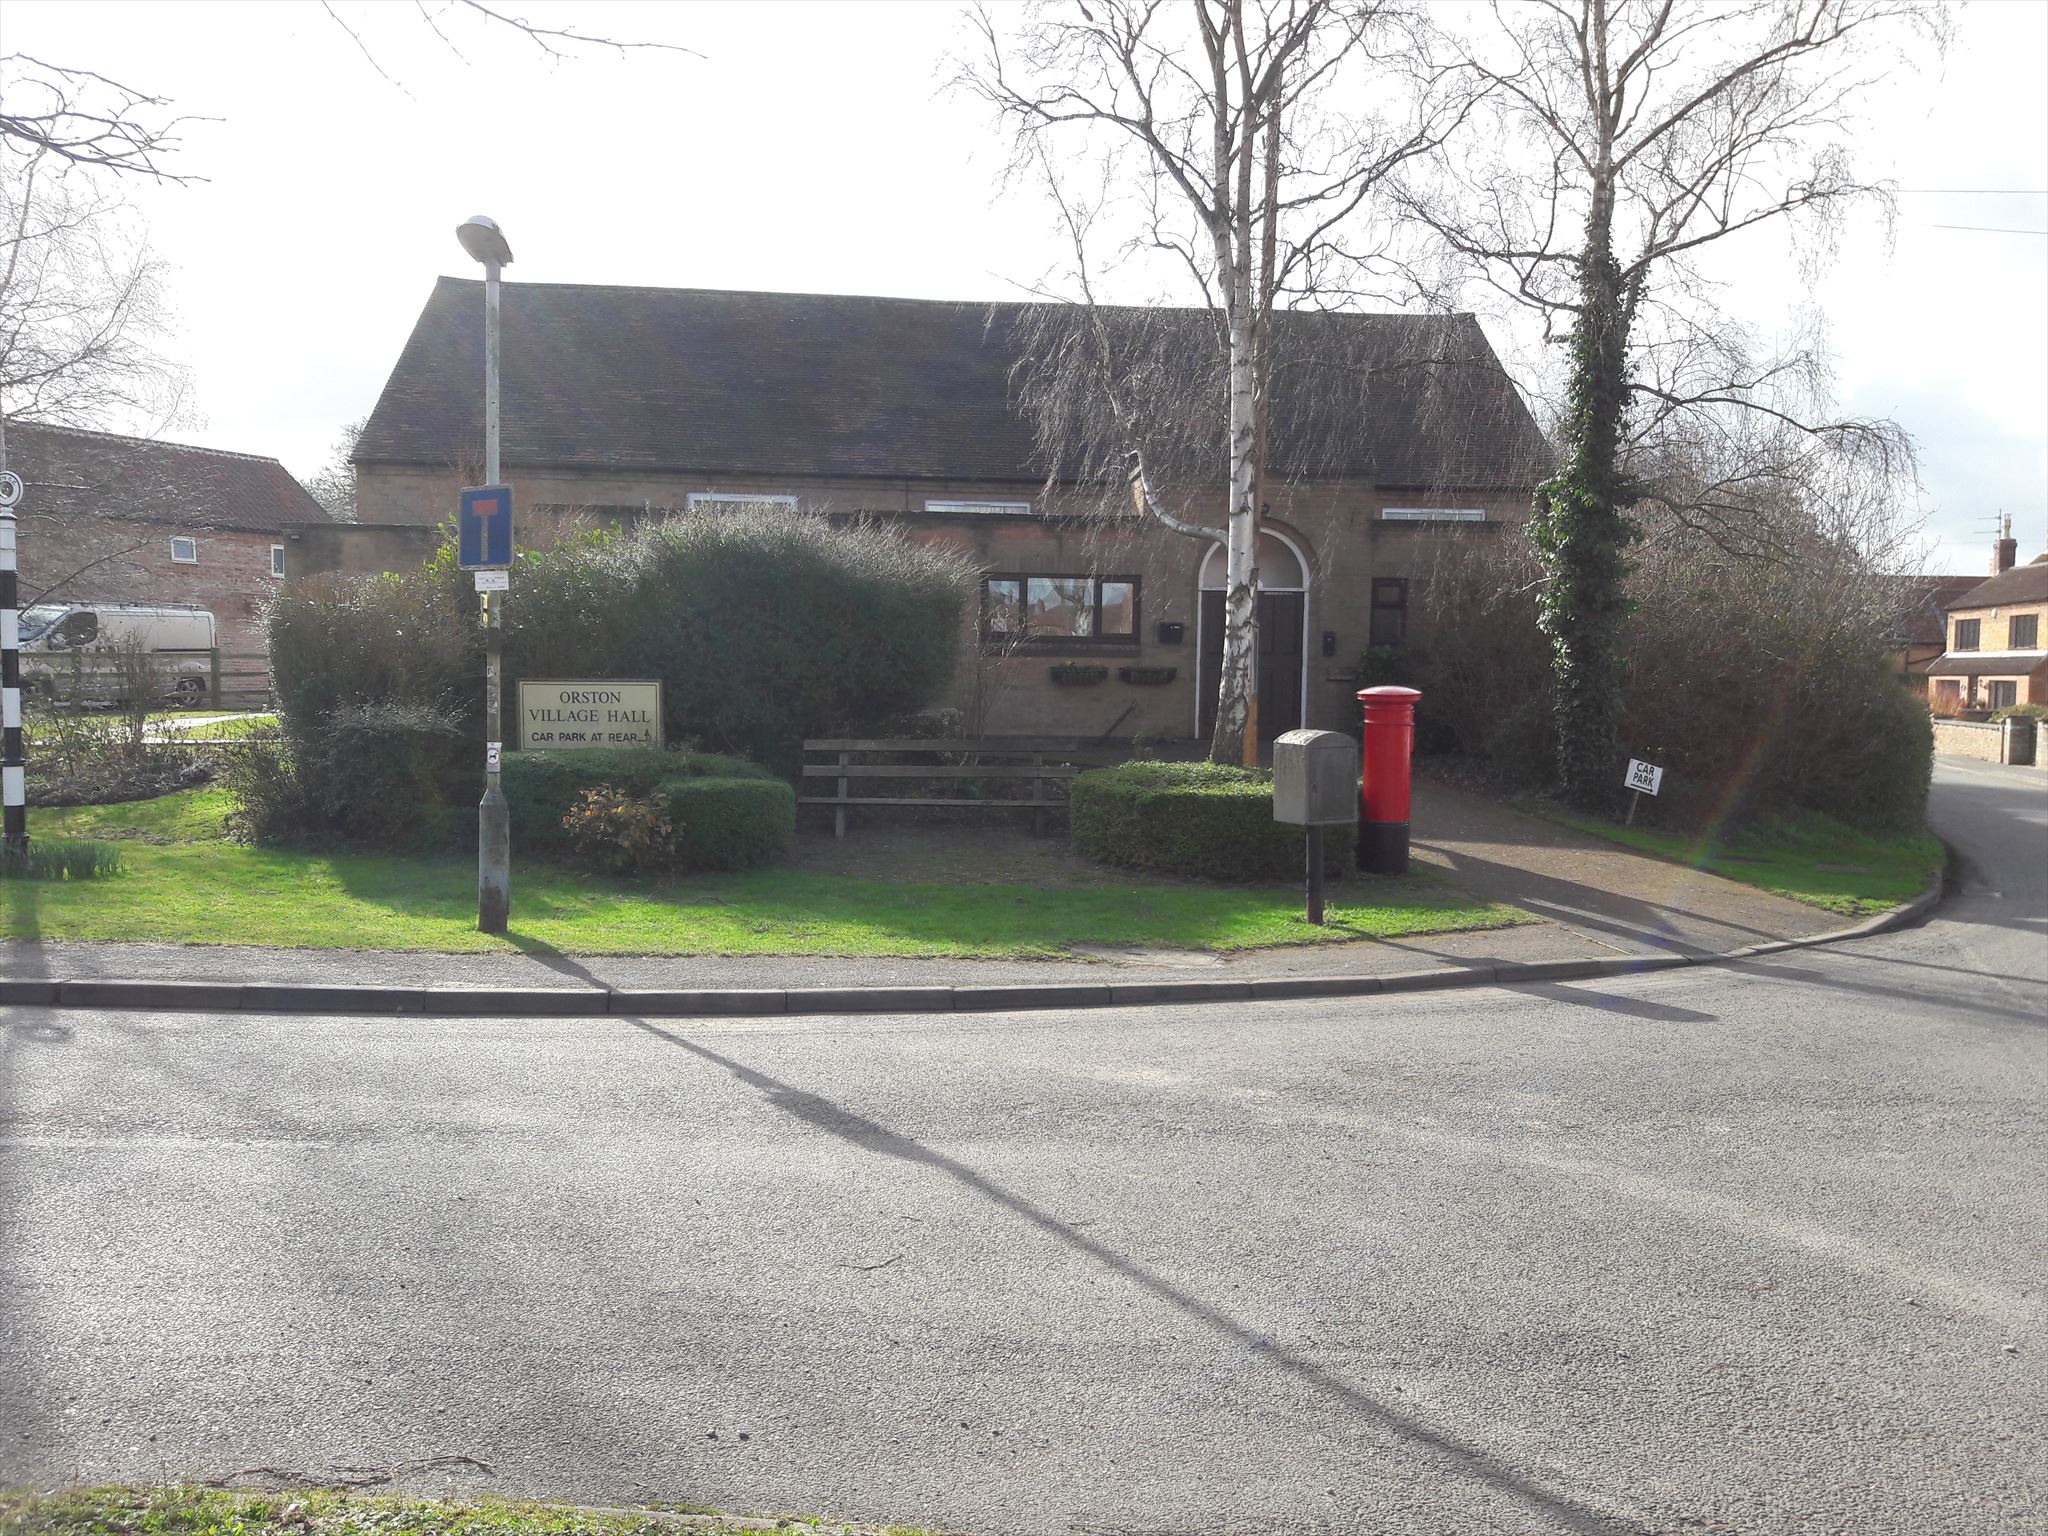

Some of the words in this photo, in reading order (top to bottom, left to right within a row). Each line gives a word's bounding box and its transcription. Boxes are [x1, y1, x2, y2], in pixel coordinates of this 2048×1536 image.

[560, 691, 621, 704] ORSTON
[529, 709, 599, 722] VILLAGE
[608, 710, 650, 723] HALL
[531, 732, 554, 742] CAR
[559, 732, 586, 742] PARK
[591, 732, 603, 742] AT
[608, 733, 637, 743] REAR
[1636, 762, 1655, 777] CAR
[1632, 772, 1654, 788] PARK
